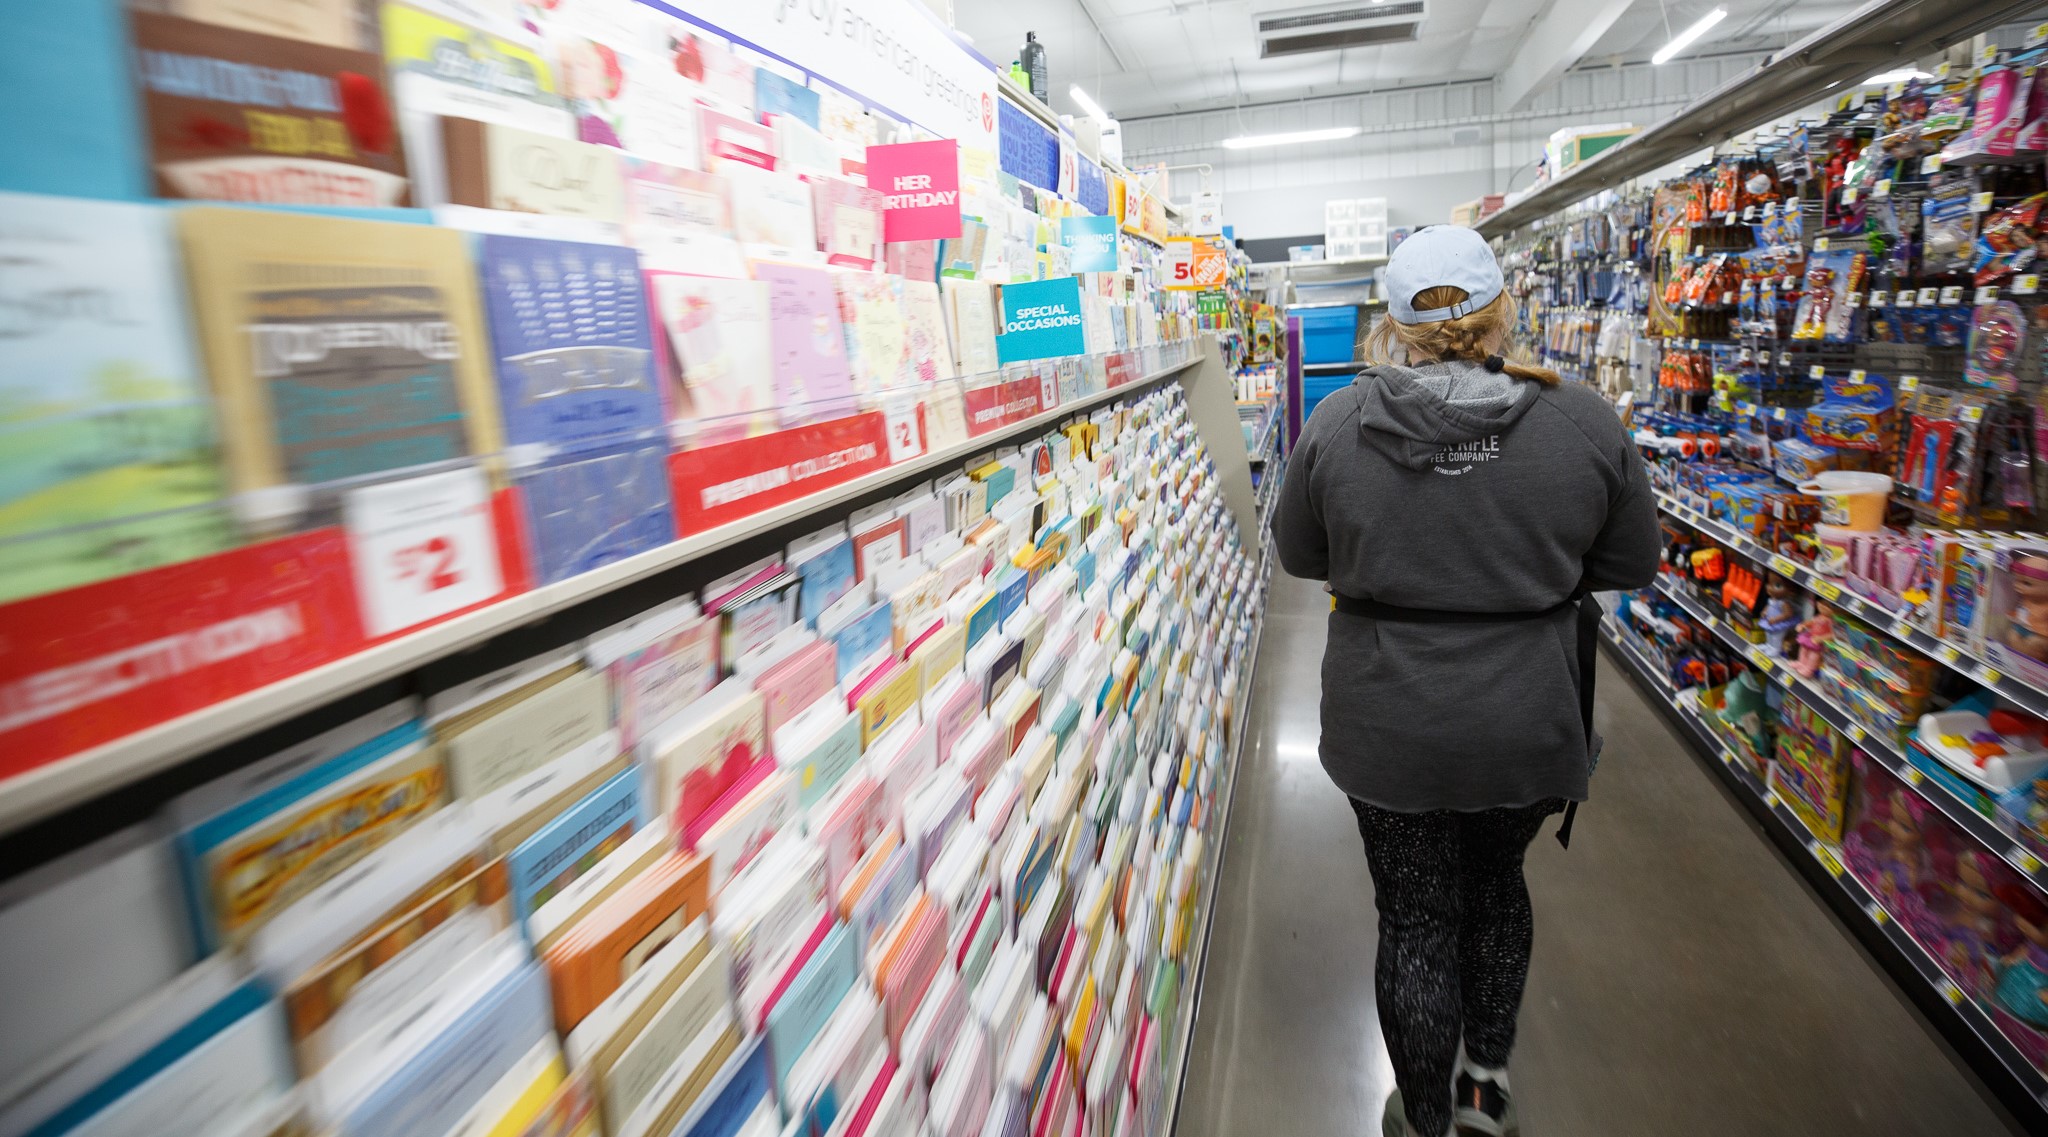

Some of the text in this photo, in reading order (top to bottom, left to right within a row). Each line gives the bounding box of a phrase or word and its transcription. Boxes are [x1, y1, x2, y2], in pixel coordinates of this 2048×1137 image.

[893, 174, 932, 192] HER
[880, 190, 958, 211] IRTHDAY
[1016, 304, 1069, 320] SPECIAL
[1007, 314, 1081, 333] OCCASIONS
[790, 441, 877, 482] COLLECTION
[1448, 452, 1491, 462] COMPANY
[1434, 466, 1461, 476] ESTABLISHED
